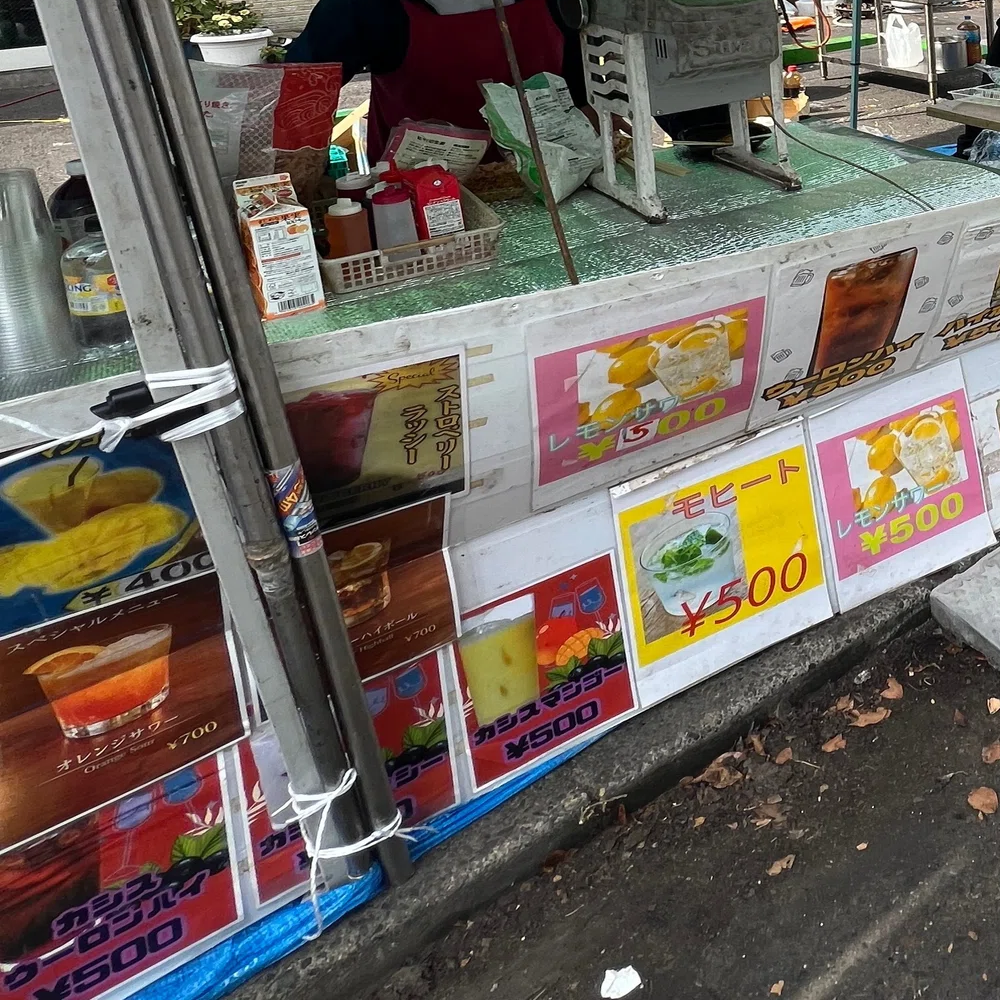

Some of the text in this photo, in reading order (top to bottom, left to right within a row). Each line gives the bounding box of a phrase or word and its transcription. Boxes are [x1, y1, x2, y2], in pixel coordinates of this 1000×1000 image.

[387, 367, 436, 385] Special
[761, 332, 926, 402] ウーロンハイ
[777, 356, 897, 411] ¥500
[399, 404, 430, 465] ラッシー
[432, 384, 463, 471] ストロベリー
[577, 397, 726, 462] ¥500
[672, 459, 800, 520] モヒート
[836, 483, 946, 540] レモンサワー
[860, 492, 964, 556] ¥500
[124, 550, 214, 594] 400
[680, 552, 808, 638] ¥500
[5, 593, 179, 656] スペシャルメニュー
[404, 623, 437, 643] ¥700
[166, 720, 218, 751] ¥700
[473, 663, 625, 747] カシスマンゴー
[503, 699, 601, 763] ¥500
[56, 714, 180, 774] オレンジサワー
[84, 754, 128, 775] Orange
[3, 870, 210, 991] ウーロンハイ
[54, 872, 162, 937] カシス
[32, 916, 184, 1000] ¥500
